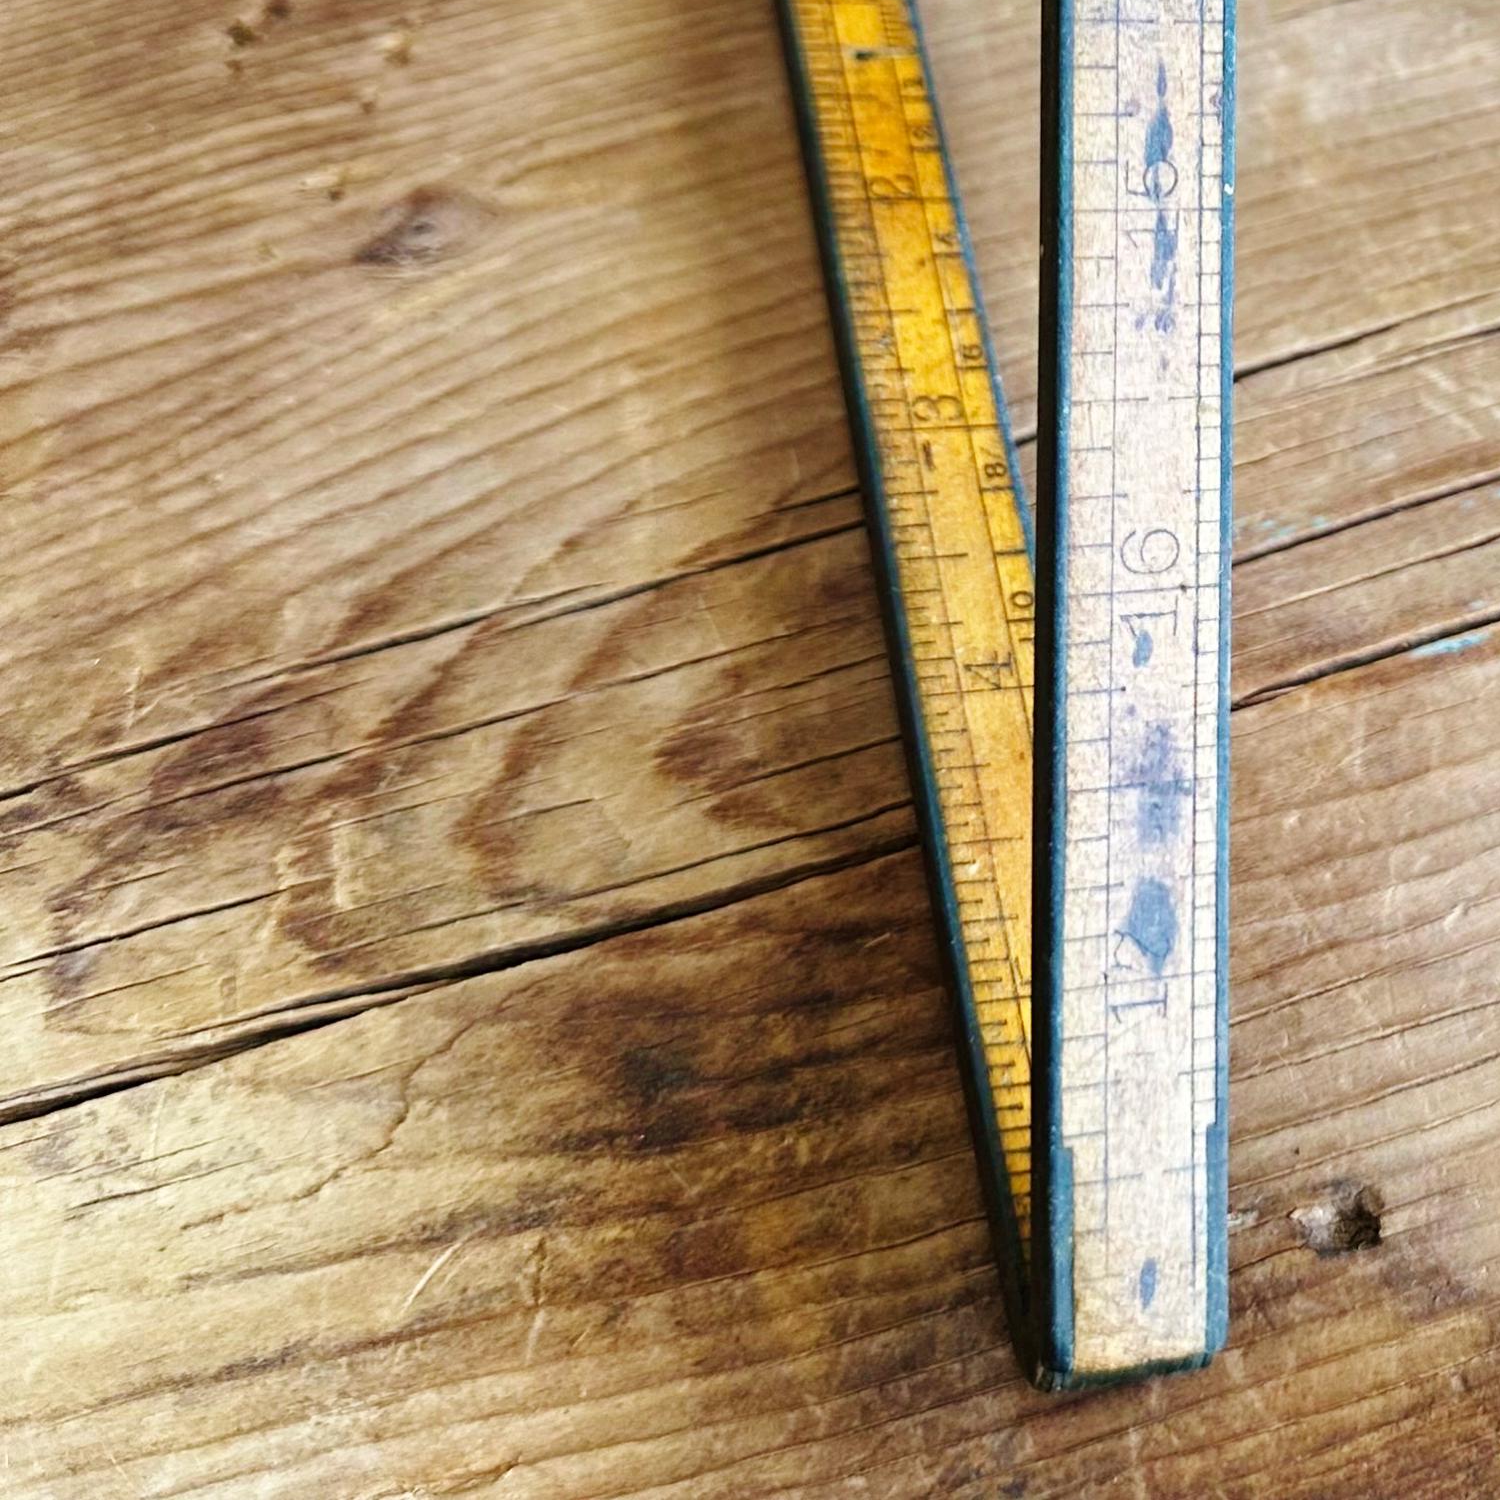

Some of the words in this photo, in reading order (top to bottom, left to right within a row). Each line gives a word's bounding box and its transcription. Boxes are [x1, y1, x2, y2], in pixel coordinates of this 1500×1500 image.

[868, 173, 918, 199] 2
[1123, 157, 1180, 250] 15
[961, 341, 984, 362] 6
[912, 393, 965, 422] 3
[984, 458, 1007, 480] 8
[1118, 527, 1181, 638] 16
[963, 648, 1015, 689] 4
[1111, 929, 1174, 1025] 17
